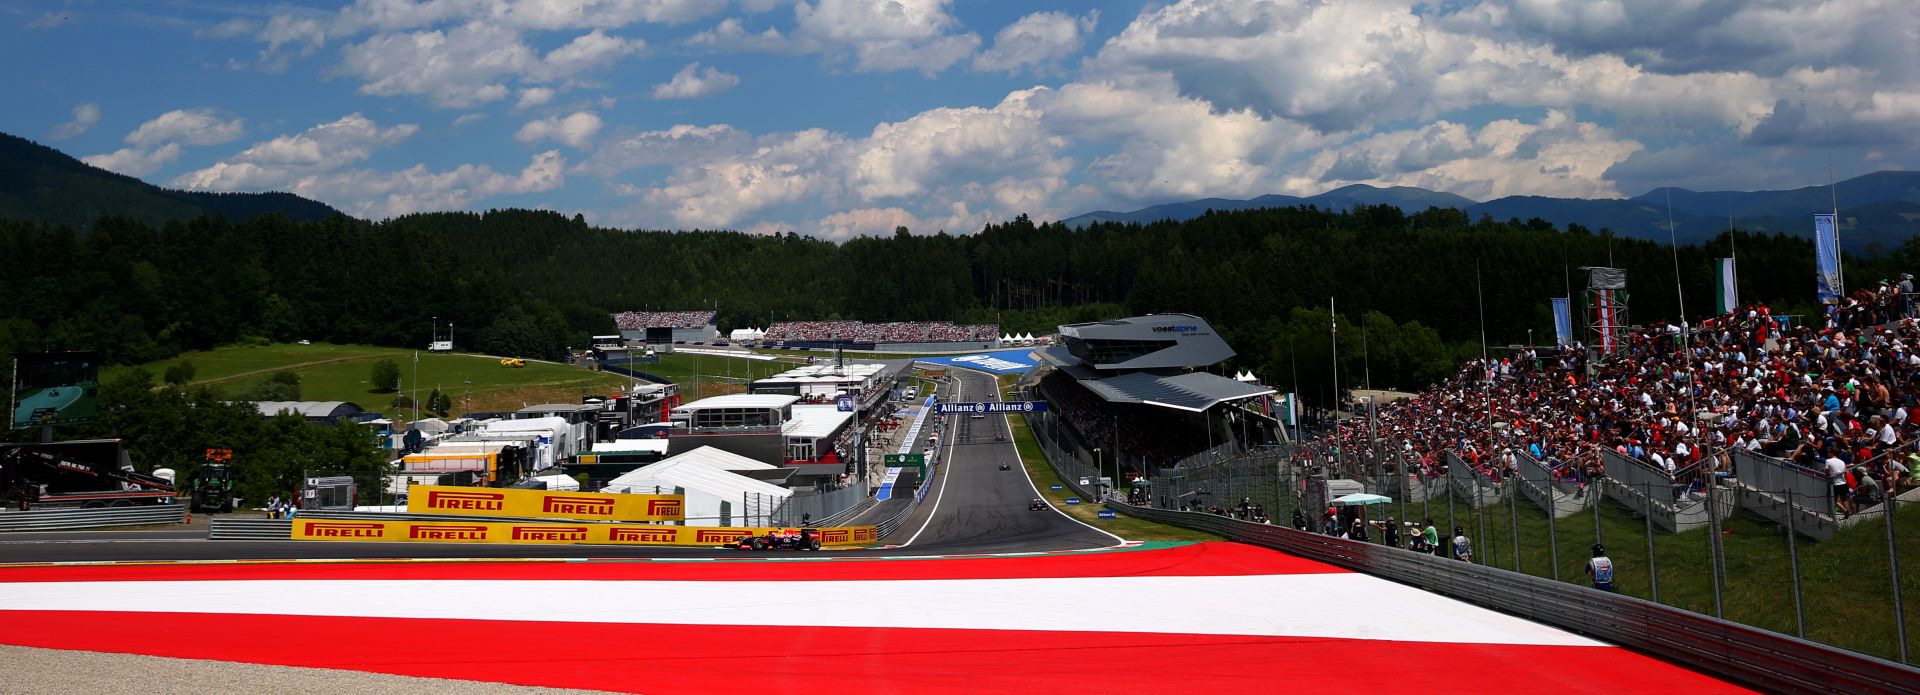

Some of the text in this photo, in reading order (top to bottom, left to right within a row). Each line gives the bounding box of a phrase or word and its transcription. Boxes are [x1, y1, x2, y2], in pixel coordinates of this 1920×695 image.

[1152, 324, 1197, 333] voestalpine
[940, 402, 1022, 413] Allianz Allianz
[428, 490, 681, 516] PIRELLI PIRELLI PIRELLI
[305, 522, 384, 538] PIRELLI
[409, 525, 487, 540] PIRELLI
[512, 526, 588, 541] PIRELLI
[609, 527, 677, 542] PIRELLI
[696, 530, 753, 543] PIREL
[821, 529, 849, 543] PIRELLI
